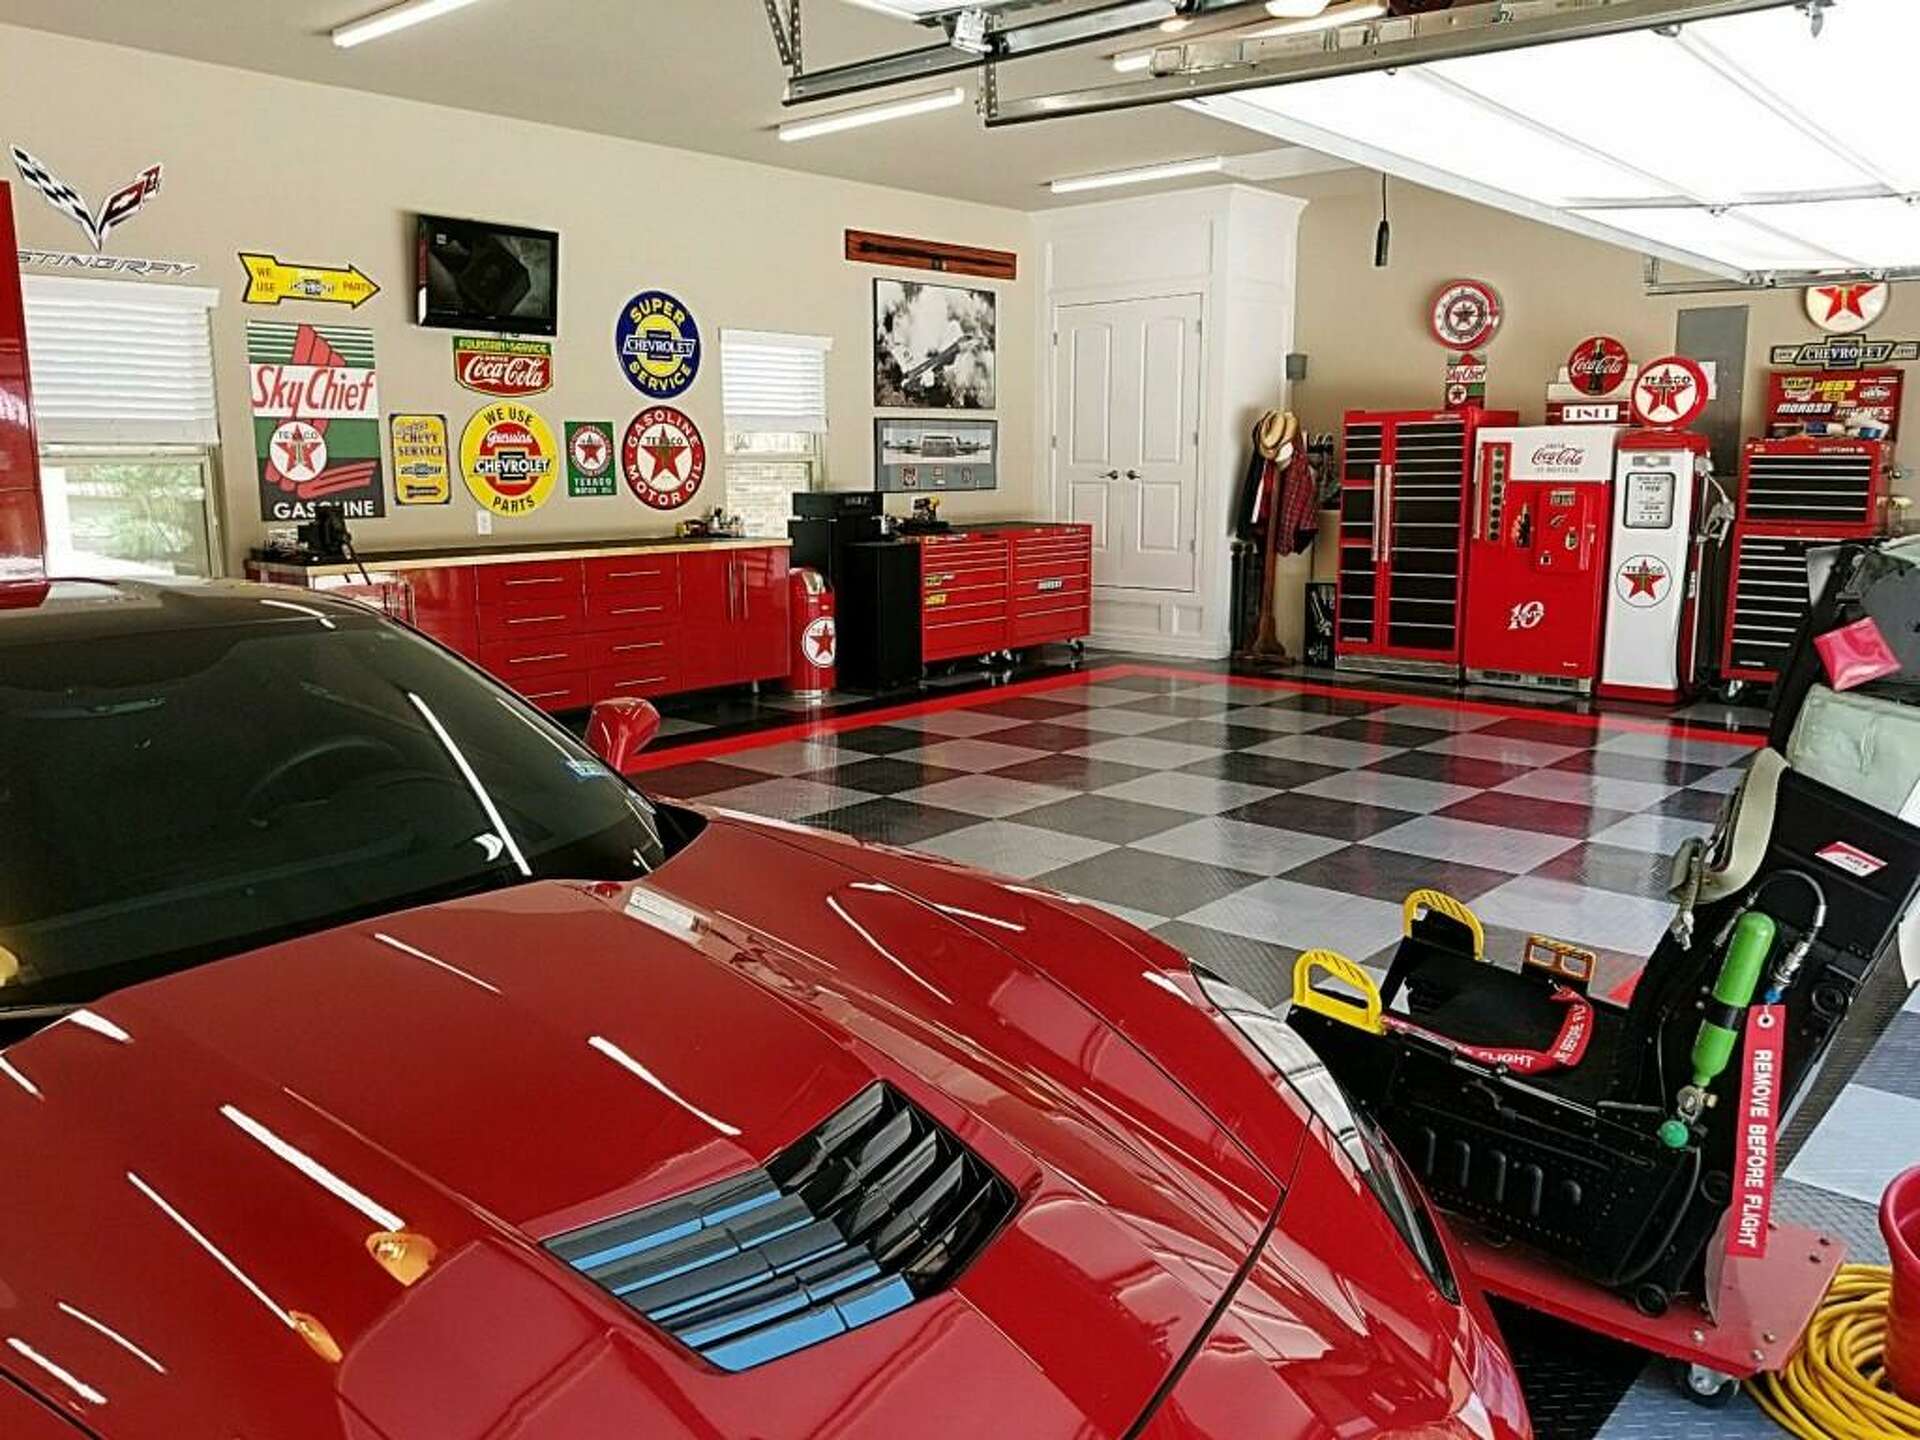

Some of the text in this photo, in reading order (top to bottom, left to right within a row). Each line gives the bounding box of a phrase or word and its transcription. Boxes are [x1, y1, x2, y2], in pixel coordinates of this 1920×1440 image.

[17, 250, 197, 276] STINGRAY
[256, 268, 271, 277] WE
[256, 282, 274, 293] USE
[630, 298, 686, 327] SUPER
[627, 339, 694, 353] CHEVROLET
[1805, 345, 1885, 360] CHEVROLET
[629, 361, 692, 391] SERVICE
[252, 366, 376, 419] Sky Chief
[484, 406, 534, 427] WE USE
[628, 410, 700, 447] GASOLINE
[475, 458, 551, 473] CHEVROLET
[628, 462, 702, 505] MOTOR OIL
[273, 500, 375, 519] GASINE
[492, 495, 535, 513] PARTS
[1478, 1051, 1535, 1068] FLIGHT
[1738, 1049, 1773, 1248] REMOVE BEFORE FLIGHT
